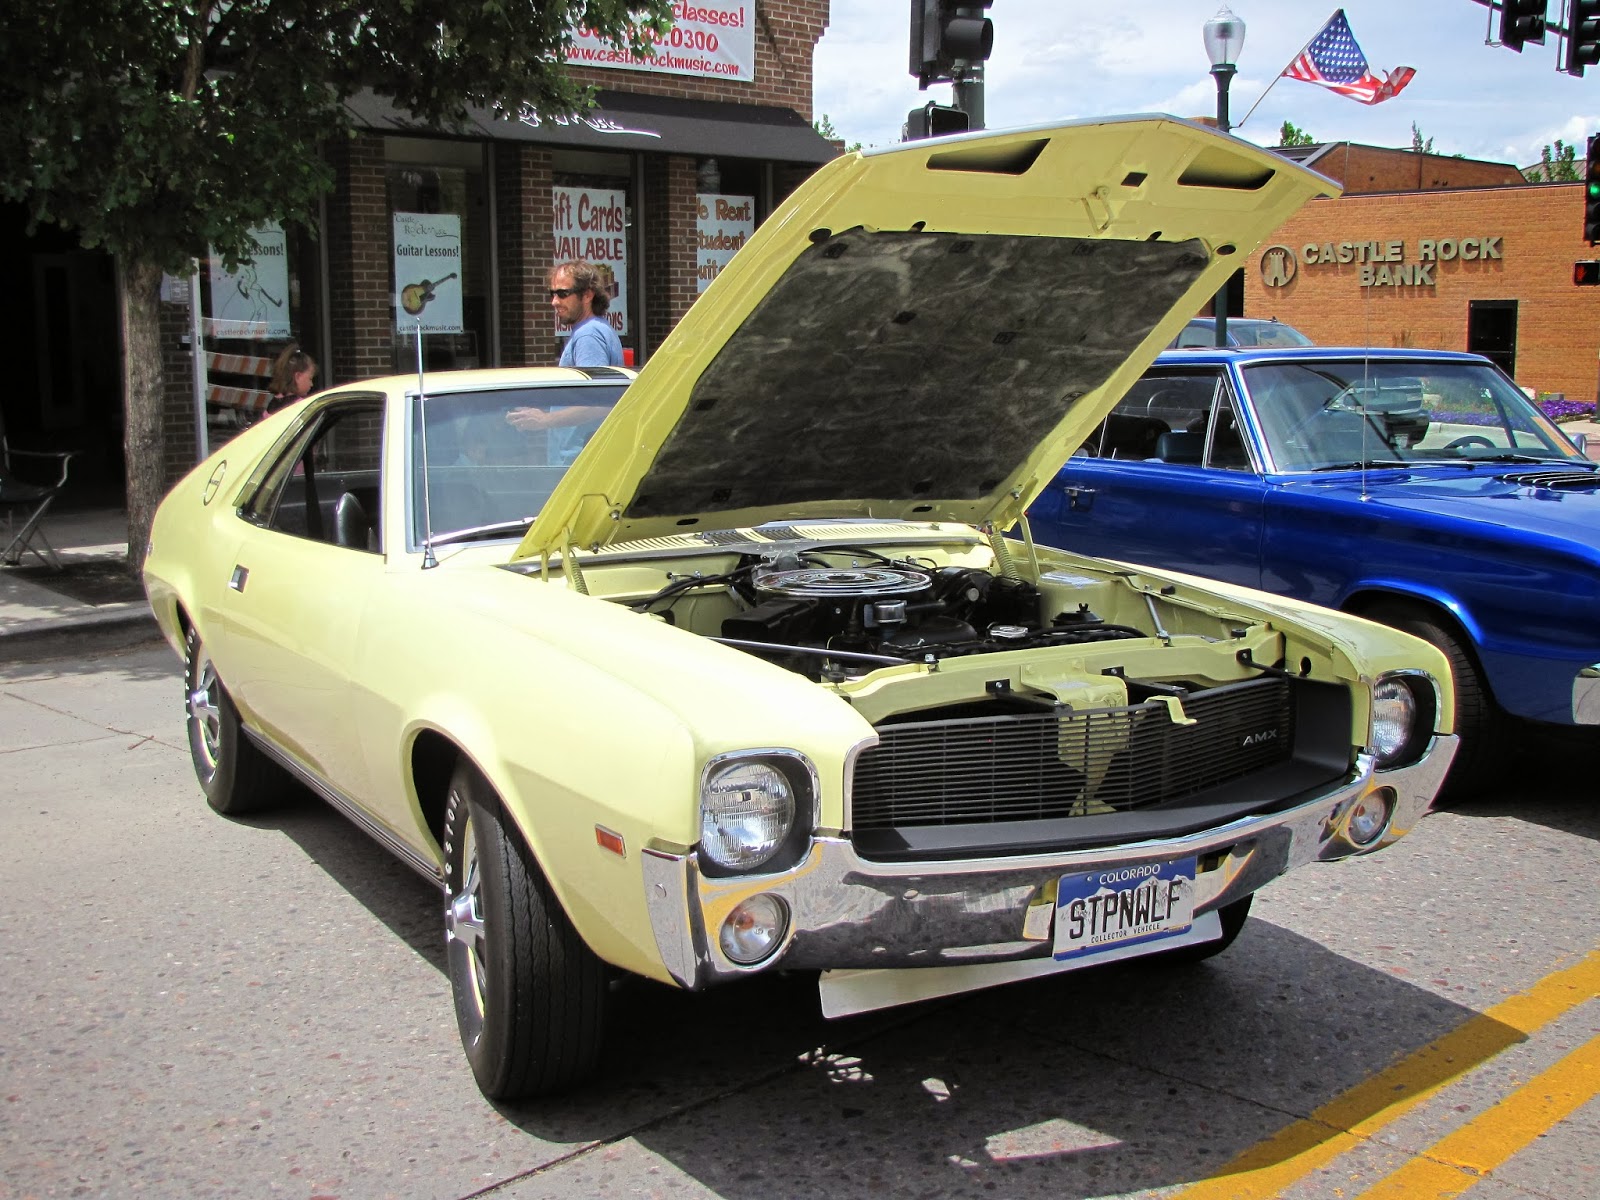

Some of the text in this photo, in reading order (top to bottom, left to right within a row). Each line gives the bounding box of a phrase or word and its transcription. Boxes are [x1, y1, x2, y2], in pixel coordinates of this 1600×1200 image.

[672, 0, 744, 28] classes!
[553, 192, 623, 232] ift Cards
[697, 197, 751, 221] e Rent
[249, 243, 284, 256] essons!
[397, 244, 459, 257] Guitar Lessons!
[553, 236, 623, 260] VAILABLE
[697, 229, 746, 250] tudent
[1303, 237, 1503, 265] CASTLE ROCK
[1359, 264, 1436, 287] BANK
[1242, 729, 1277, 746] AMX
[1100, 864, 1161, 885] COLORADO
[1069, 880, 1182, 939] STPNWLF
[1091, 922, 1160, 943] COLLECTOR VEHICLE
